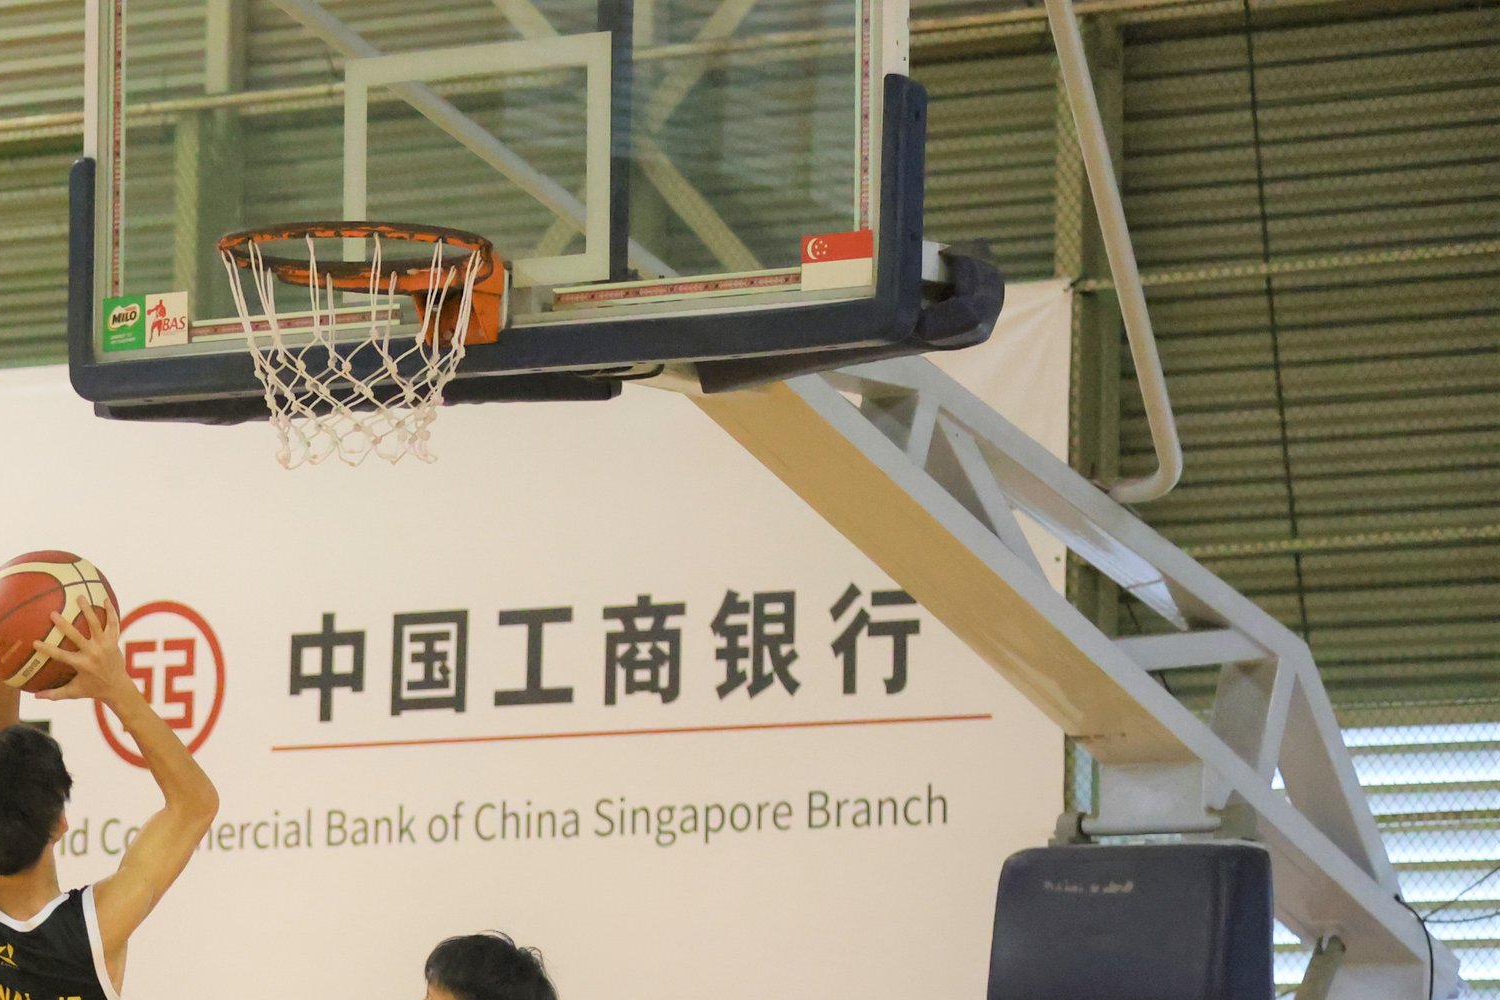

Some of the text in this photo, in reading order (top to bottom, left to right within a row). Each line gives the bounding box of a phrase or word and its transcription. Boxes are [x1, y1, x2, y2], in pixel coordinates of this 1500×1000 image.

[112, 310, 137, 325] MILO
[162, 316, 186, 331] BAS
[288, 582, 921, 723] 中国工商银行
[100, 808, 313, 856] Cercial
[326, 804, 416, 847] Bank
[428, 801, 465, 843] of
[474, 800, 580, 841] China
[594, 796, 794, 847] Singapore
[807, 783, 948, 829] Branch
